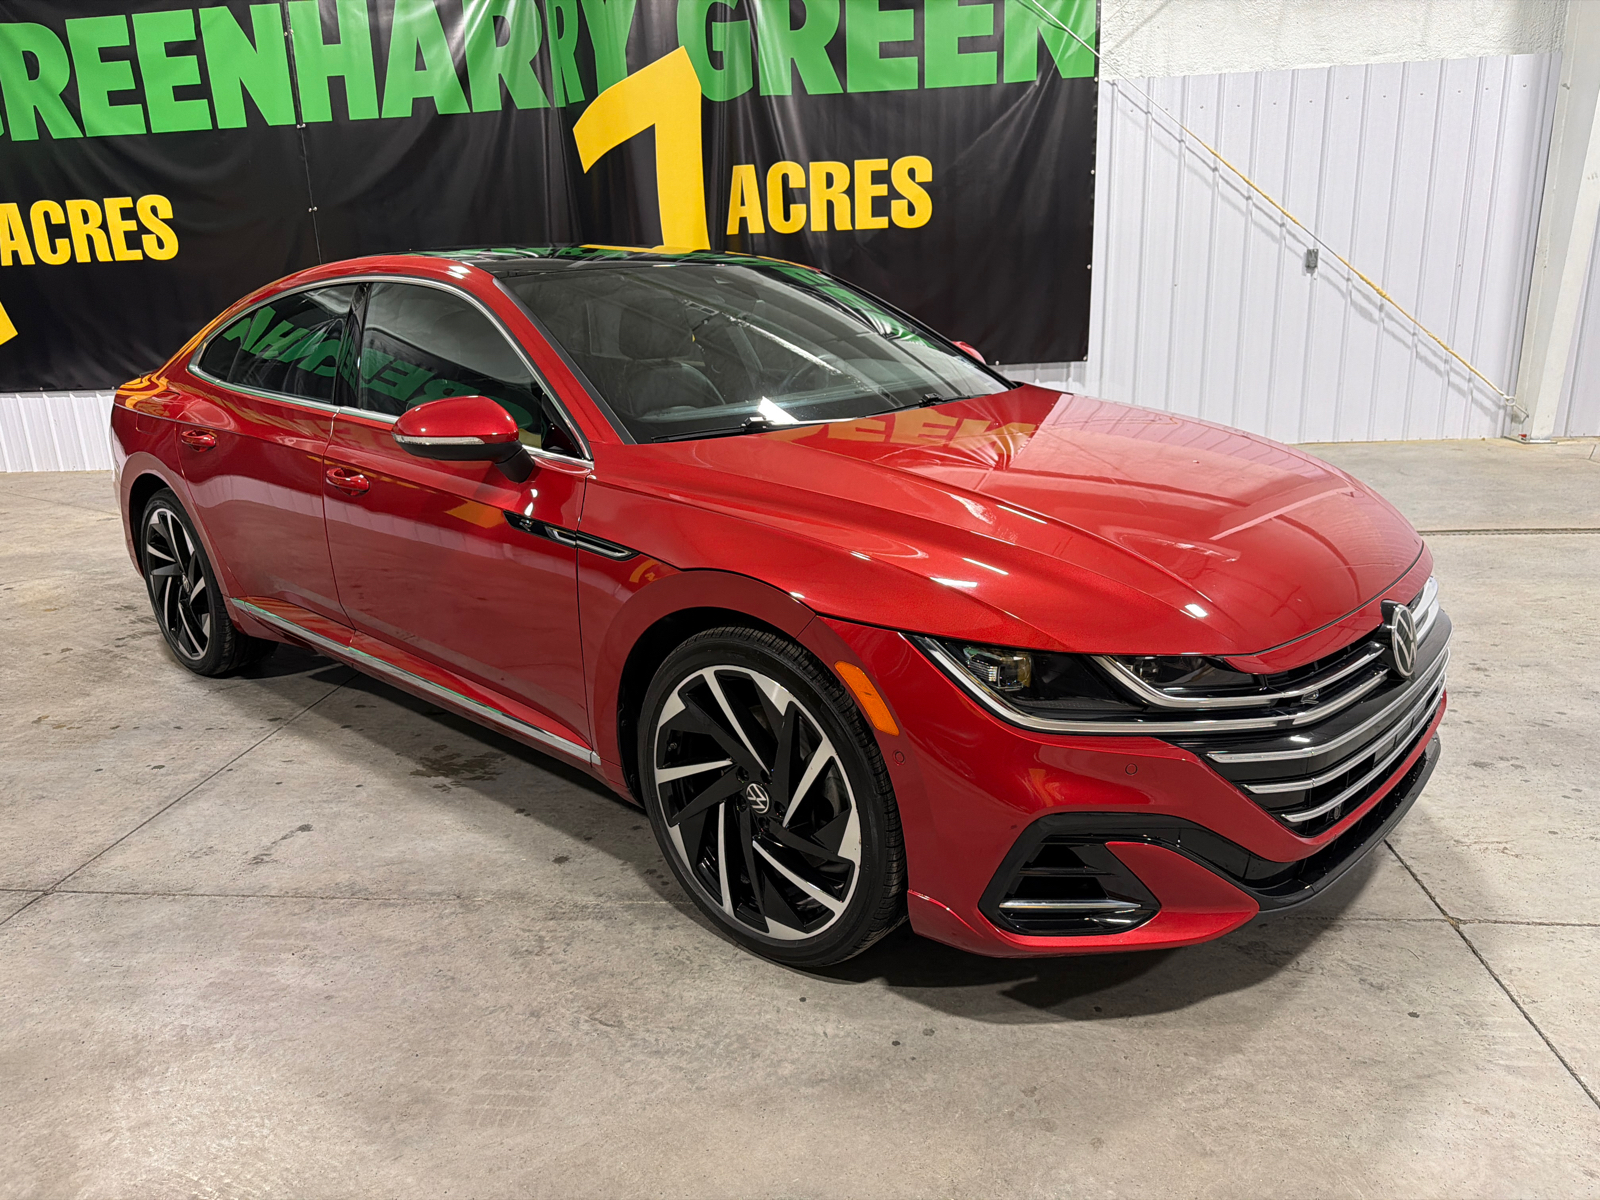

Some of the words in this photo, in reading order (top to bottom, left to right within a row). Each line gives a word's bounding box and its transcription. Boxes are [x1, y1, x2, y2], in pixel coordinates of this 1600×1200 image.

[0, 3, 298, 141] REEN
[289, 0, 637, 123] HARRY
[677, 0, 1096, 102] GREEN
[573, 45, 711, 252] 7
[726, 155, 933, 235] ACRES
[0, 194, 179, 266] ACRES
